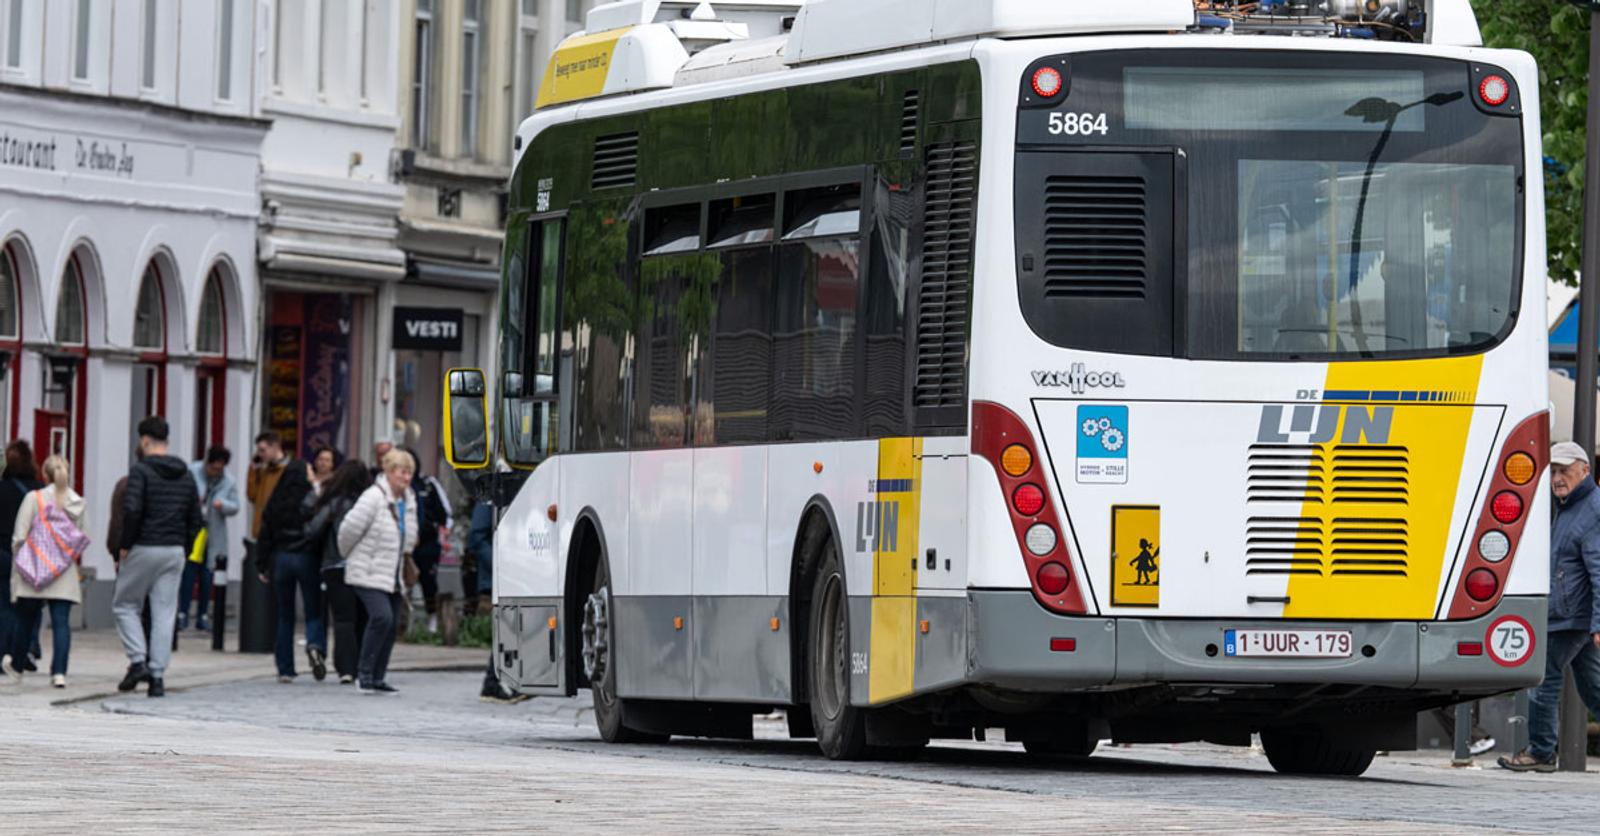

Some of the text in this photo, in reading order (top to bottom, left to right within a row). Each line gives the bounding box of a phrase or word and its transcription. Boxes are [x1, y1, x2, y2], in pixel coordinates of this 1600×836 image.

[1048, 112, 1109, 135] 5864
[0, 133, 56, 171] taurant
[406, 320, 457, 337] VESTI
[1296, 389, 1318, 400] DE
[1257, 405, 1394, 444] LIJN
[856, 501, 899, 552] LIJN
[1227, 645, 1234, 653] B
[1497, 627, 1525, 649] 75
